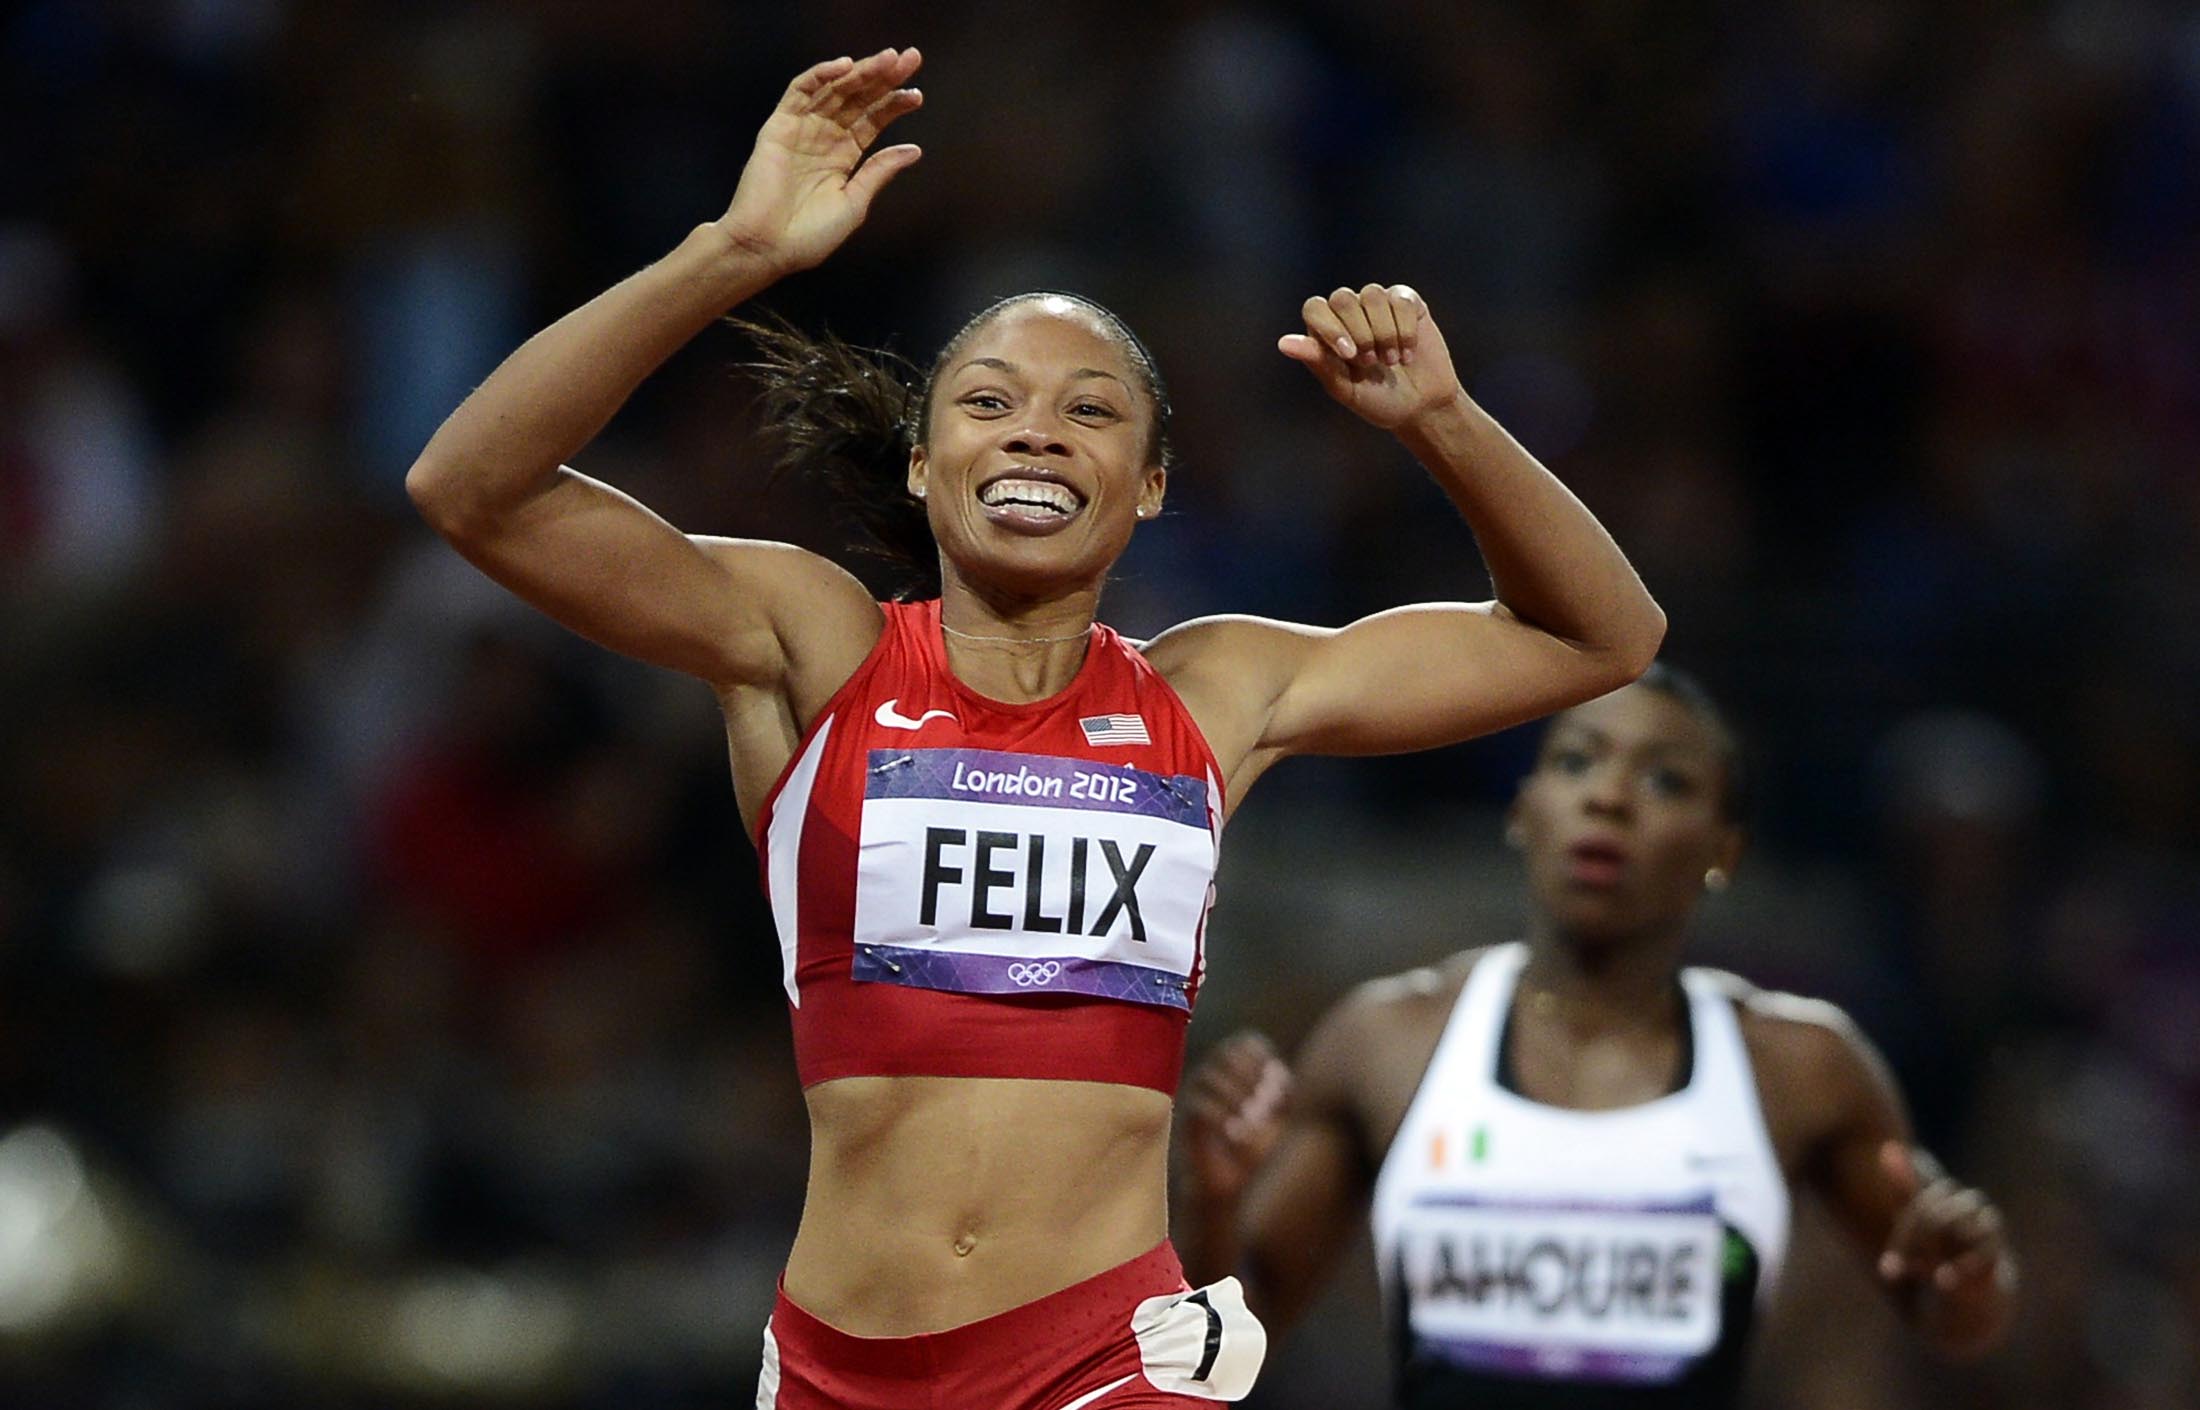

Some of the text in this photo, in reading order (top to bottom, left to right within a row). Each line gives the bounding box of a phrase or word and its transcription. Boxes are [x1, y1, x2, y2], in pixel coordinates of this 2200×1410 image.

[952, 761, 1138, 804] London 2012
[919, 826, 1157, 943] FELIX
